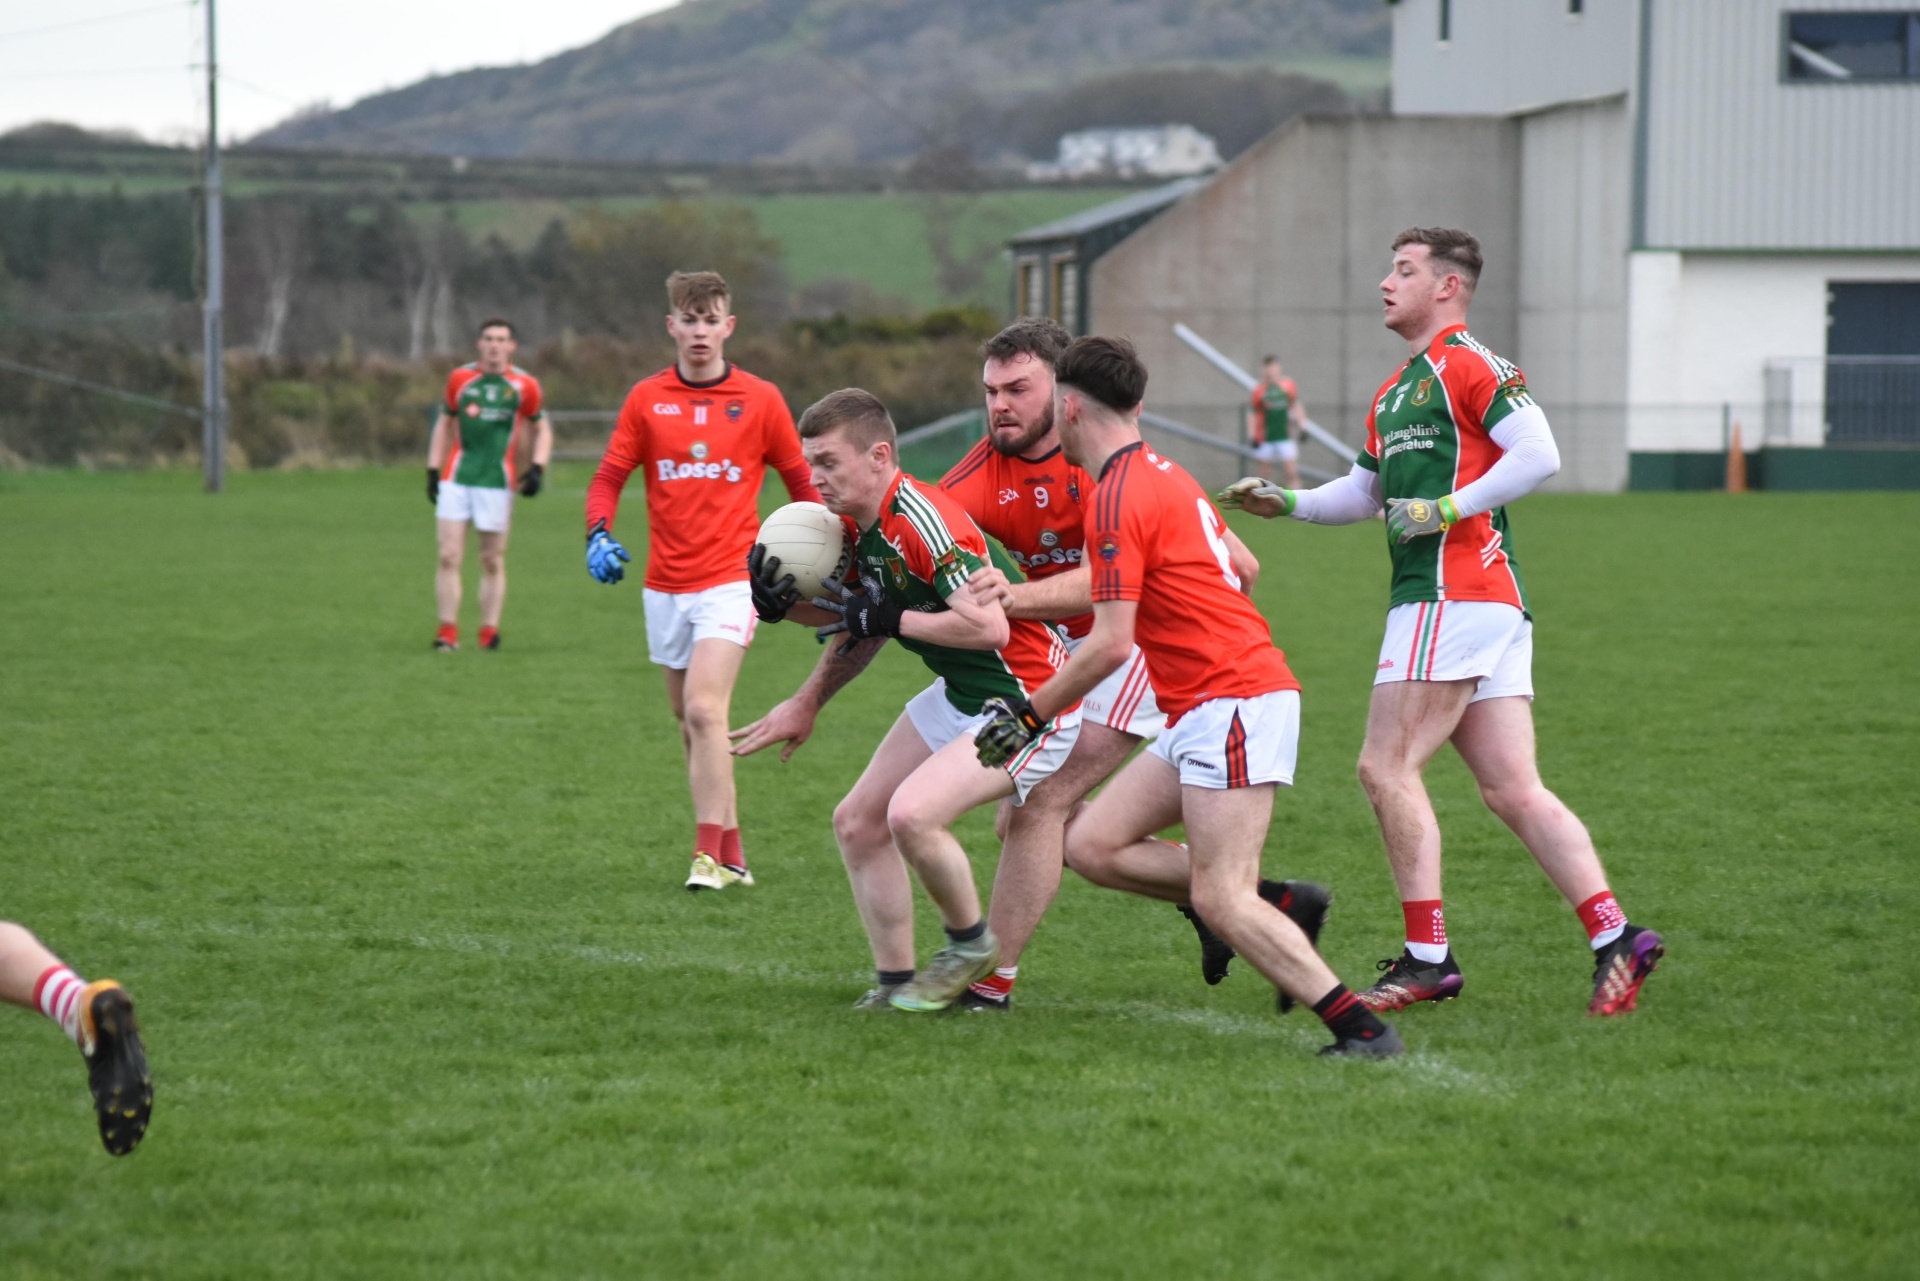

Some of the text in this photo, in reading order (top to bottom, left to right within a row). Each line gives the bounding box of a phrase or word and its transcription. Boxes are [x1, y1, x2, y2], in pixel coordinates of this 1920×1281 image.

[653, 403, 682, 415] GAA
[1392, 394, 1404, 412] 8
[694, 407, 706, 424] 11
[656, 459, 742, 482] Rose's
[1034, 487, 1049, 508] 9
[874, 568, 886, 587] 7
